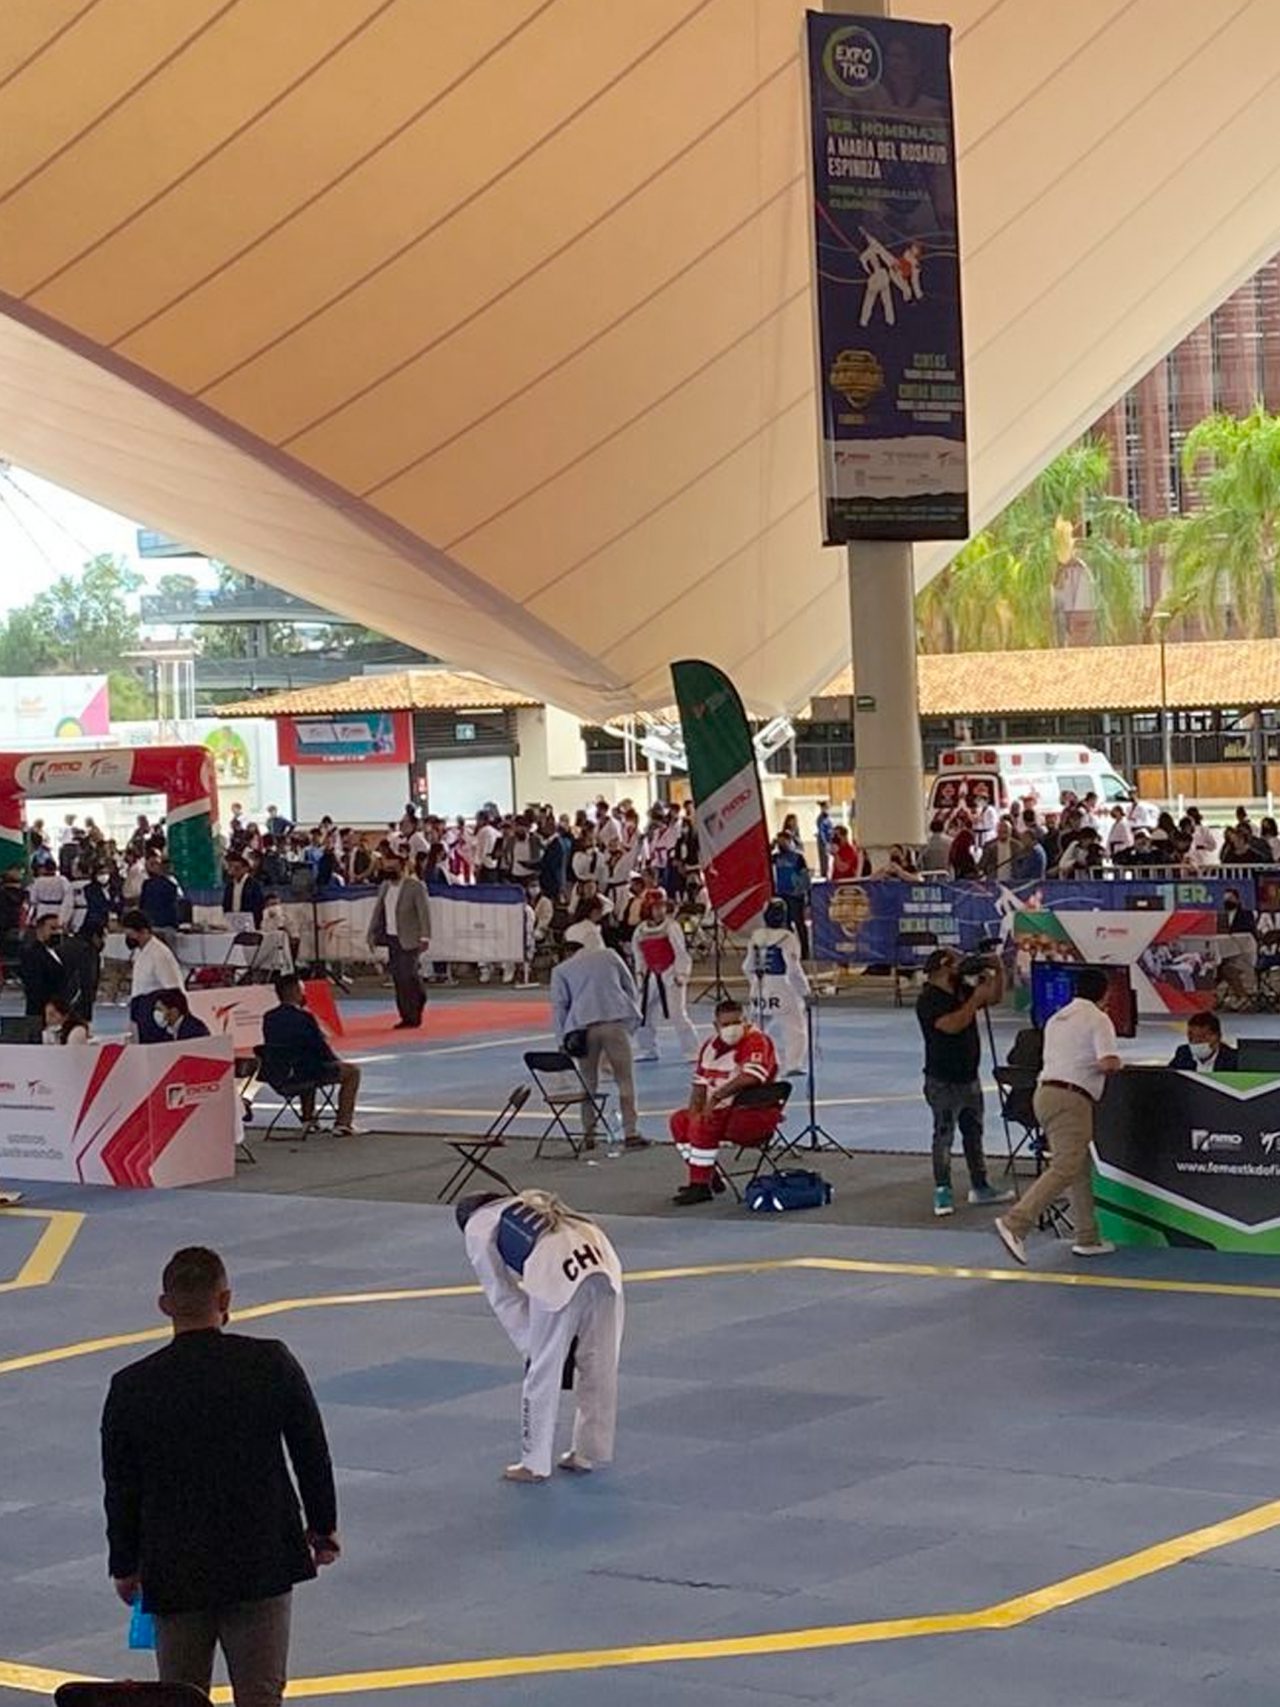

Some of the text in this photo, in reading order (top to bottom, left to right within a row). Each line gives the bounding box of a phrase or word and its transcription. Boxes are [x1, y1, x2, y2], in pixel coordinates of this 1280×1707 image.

[834, 46, 872, 62] EXPO
[841, 62, 868, 79] TKD
[877, 141, 899, 161] DEL
[562, 1244, 605, 1283] CH
